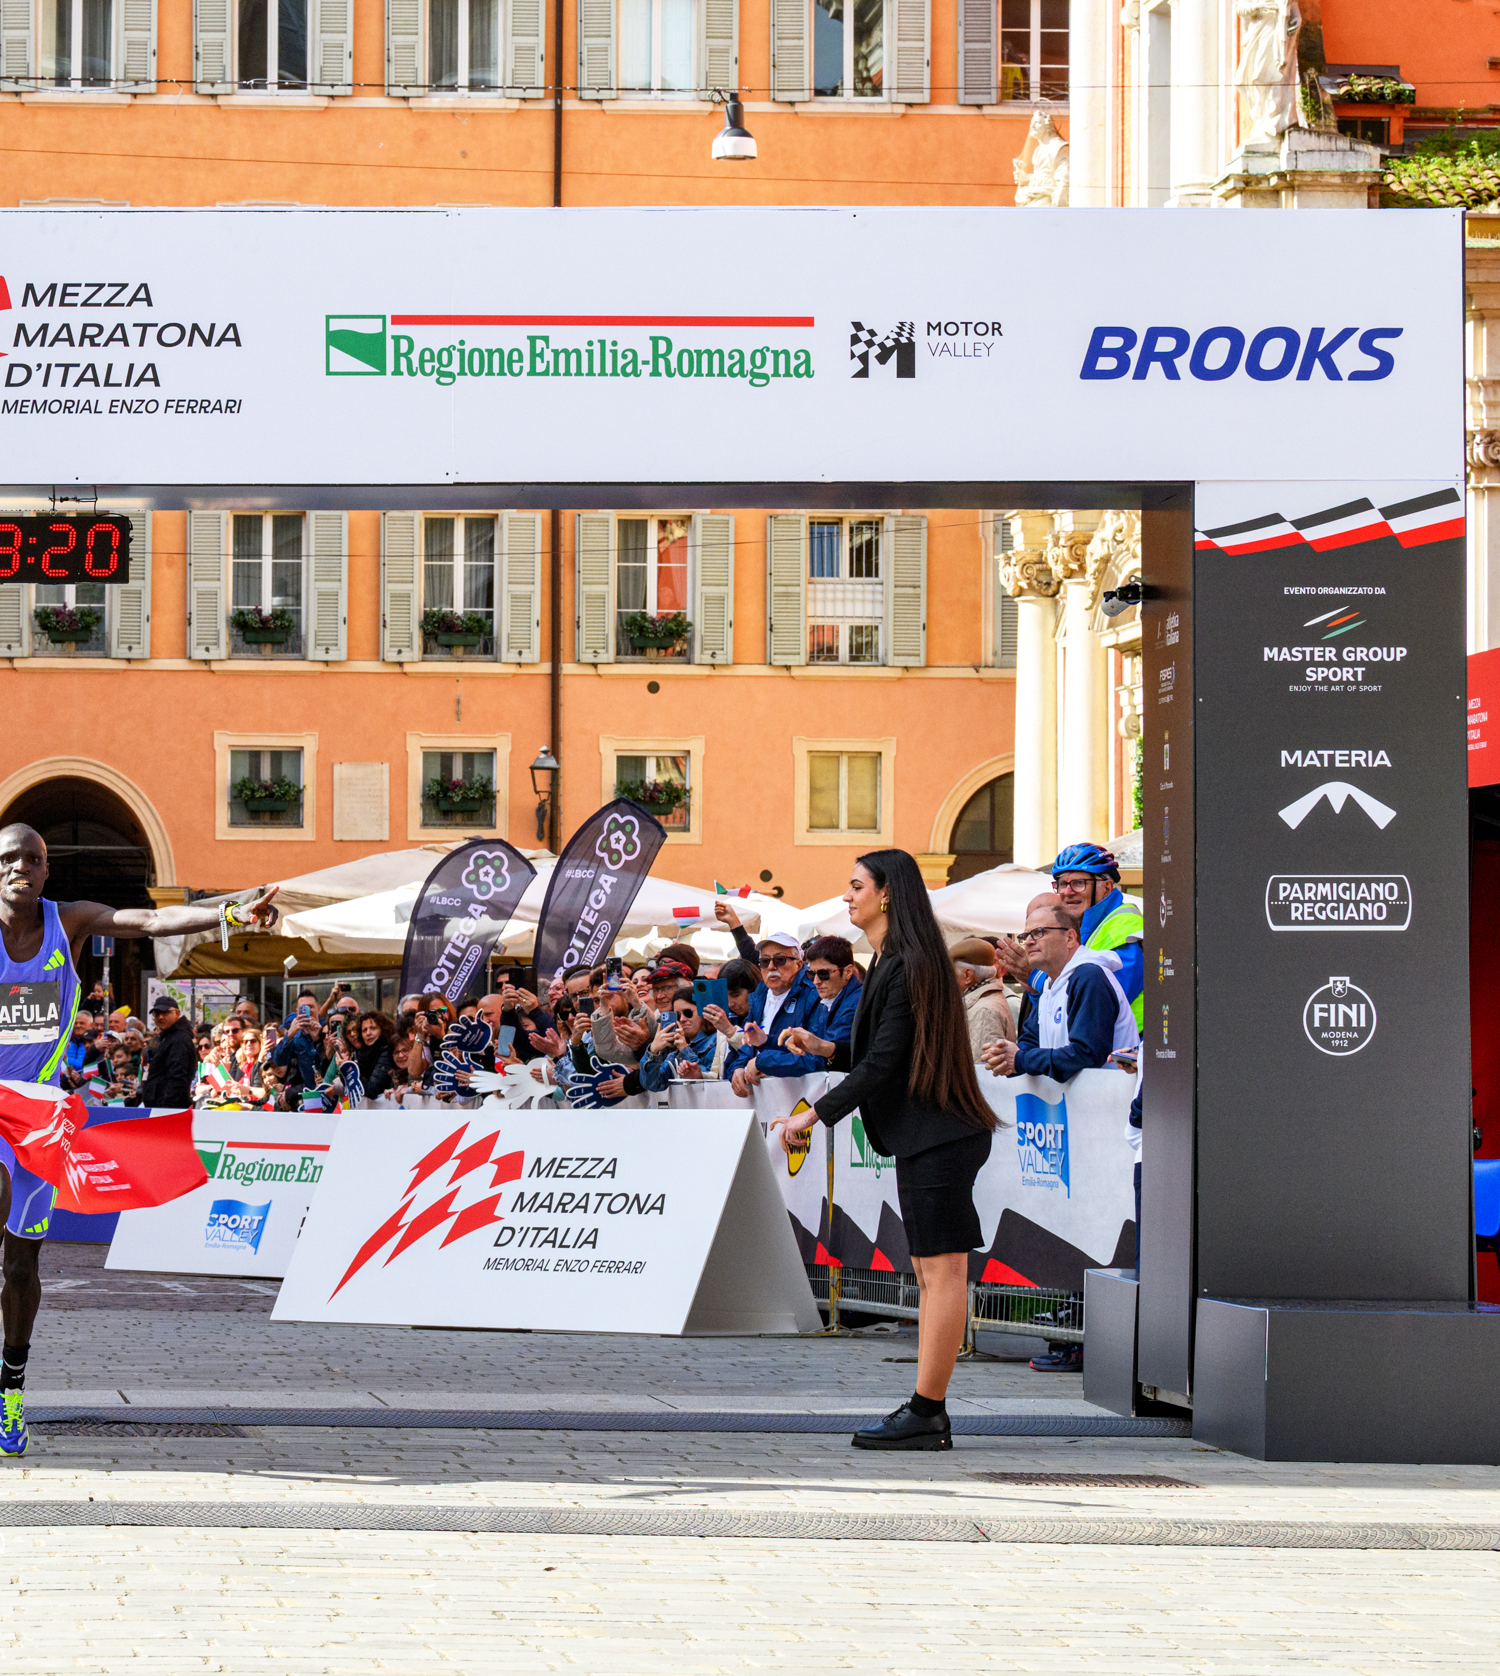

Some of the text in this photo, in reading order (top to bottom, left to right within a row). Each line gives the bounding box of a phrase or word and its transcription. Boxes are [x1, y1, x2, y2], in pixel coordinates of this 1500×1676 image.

[21, 283, 153, 307] MEZZA
[13, 323, 241, 347] MARATONA
[926, 321, 1003, 336] MOTOR
[927, 342, 995, 358] VALLEY
[1079, 326, 1403, 381] BROOKS
[4, 363, 160, 388] D'ITALIA
[1, 399, 242, 414] MEMORIAL ENZO FERRARI
[1284, 587, 1316, 595] EVENTO
[1318, 587, 1372, 595] ORGANIZZATO
[1263, 646, 1408, 662] MASTER GROUP
[1305, 667, 1365, 682] SPORT
[1280, 750, 1392, 767] MATERIA
[430, 896, 462, 906] #LBCC
[1279, 883, 1398, 901] PARMIGIANO
[1291, 902, 1387, 921] REGGIANO
[423, 903, 488, 994] BOTTEGA
[448, 947, 480, 999] CASINALBO
[1313, 1004, 1367, 1028] FINI
[1321, 1031, 1359, 1039] MODENA
[63, 1118, 76, 1136] EZZA
[1017, 1121, 1064, 1149] SPORT
[527, 1157, 618, 1179] MEZZA
[1017, 1148, 1065, 1176] VALLEY
[1022, 1175, 1059, 1191] Emilia-Romagna
[510, 1191, 666, 1215] MARATONA
[207, 1213, 263, 1230] SPORT
[205, 1228, 258, 1243] VALLEY
[493, 1226, 599, 1249] D'ITALIA
[204, 1242, 246, 1250] Emilia-Romagna
[483, 1257, 647, 1274] MEMORIAL ENZO FERRARI
